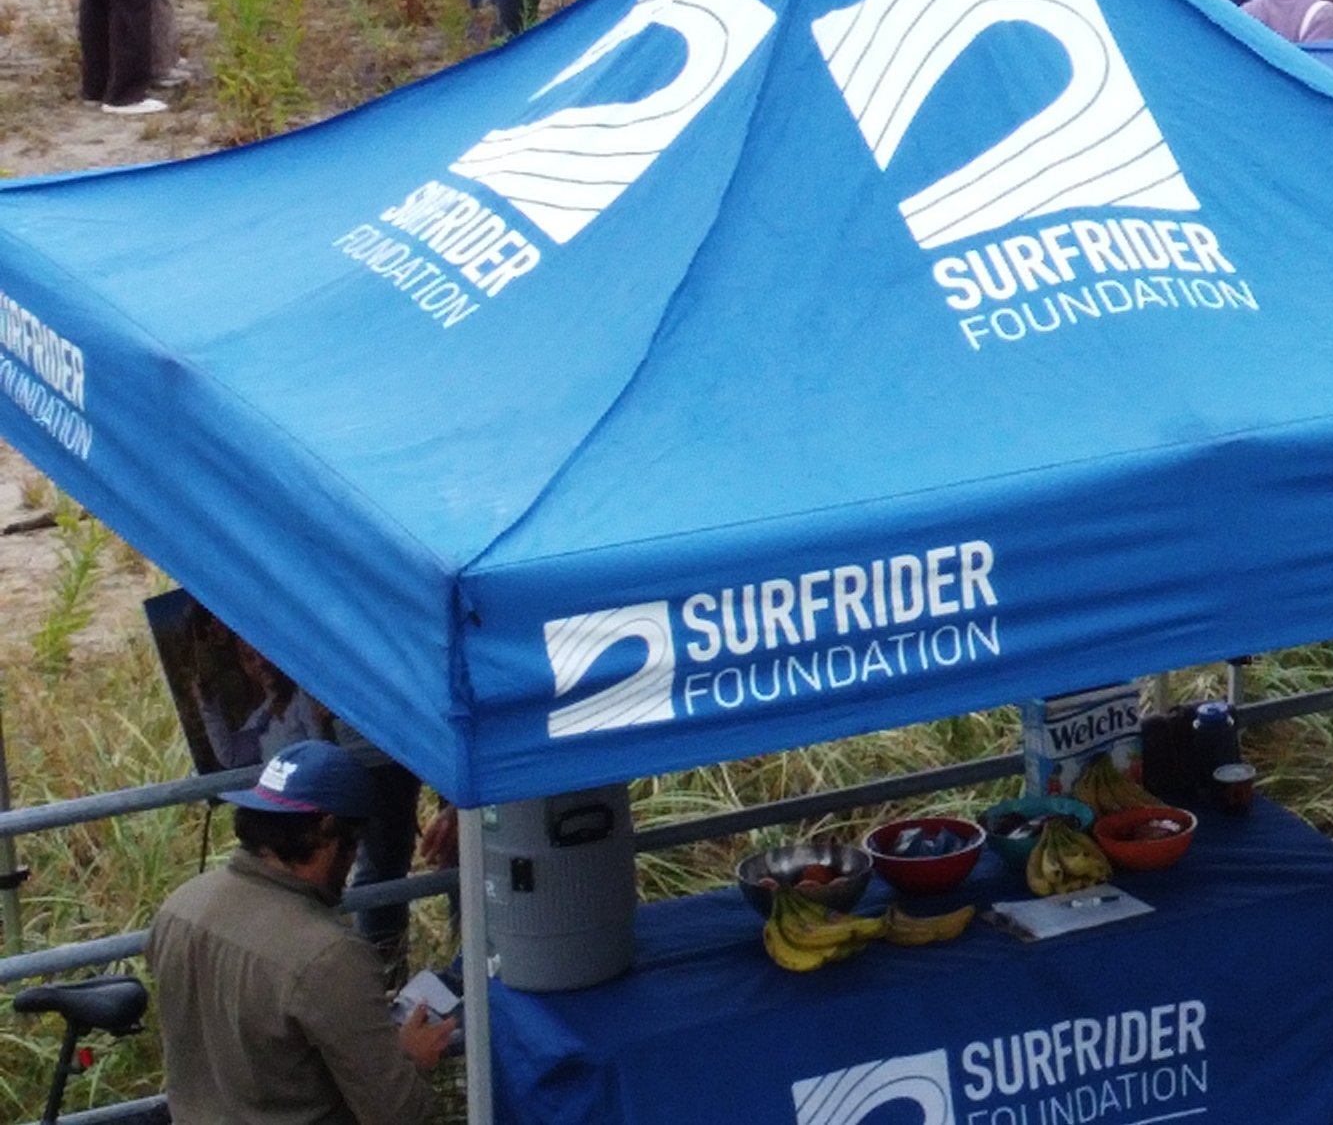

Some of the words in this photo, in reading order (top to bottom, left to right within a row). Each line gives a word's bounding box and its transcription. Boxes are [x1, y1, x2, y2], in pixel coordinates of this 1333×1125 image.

[932, 219, 1237, 311] SURFRIDER
[959, 276, 1260, 352] FOUNDATION
[682, 540, 998, 663] SURFRIDER
[683, 616, 1000, 715] FOUNDATION
[1048, 704, 1138, 752] Welch's
[962, 999, 1207, 1101] SURFRIDER
